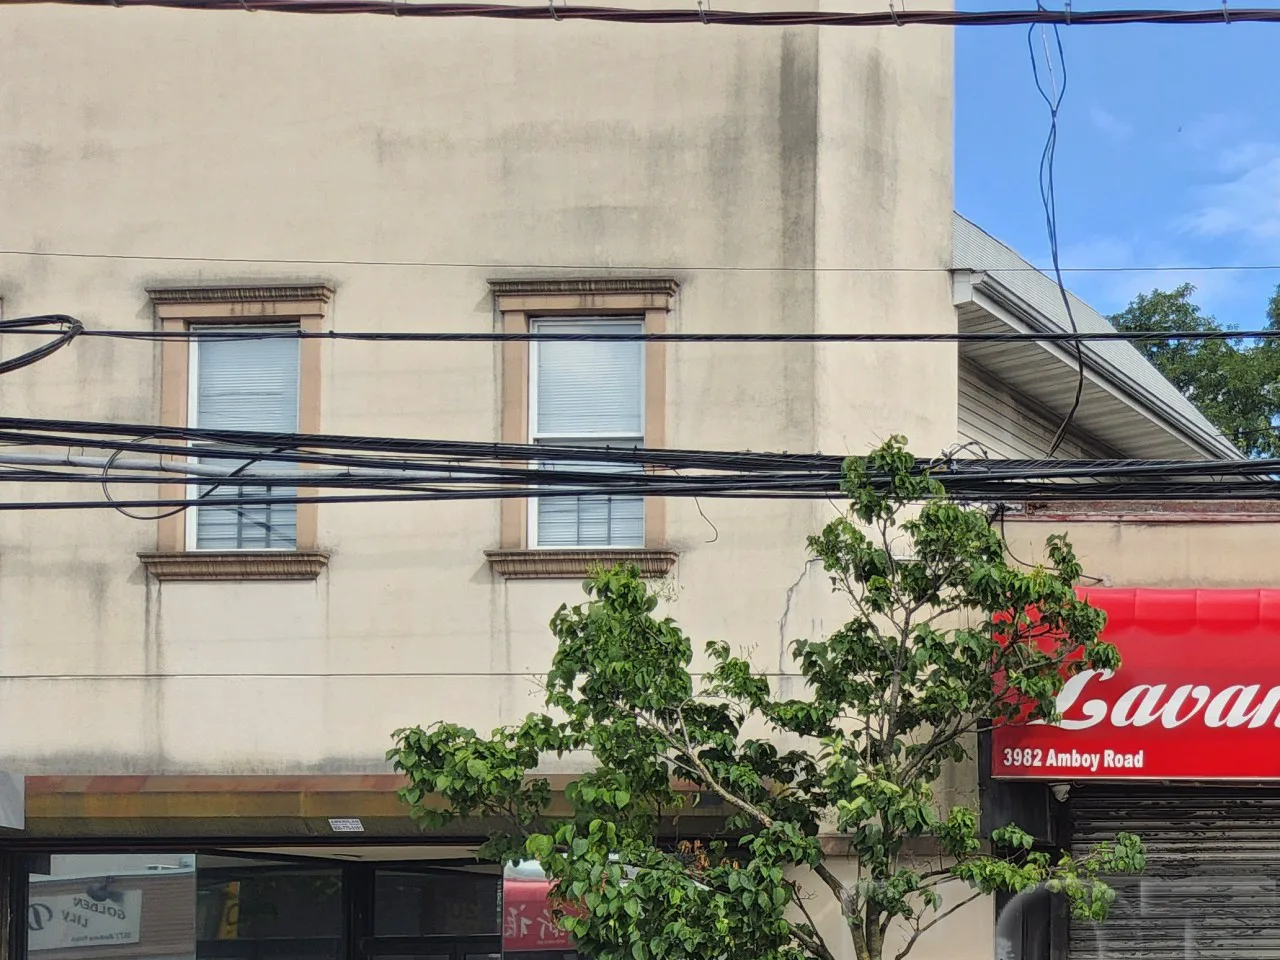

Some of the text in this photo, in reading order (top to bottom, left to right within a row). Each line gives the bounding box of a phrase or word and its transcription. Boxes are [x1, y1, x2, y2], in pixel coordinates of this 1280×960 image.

[1003, 748, 1144, 772] 3982 Amboy Road
